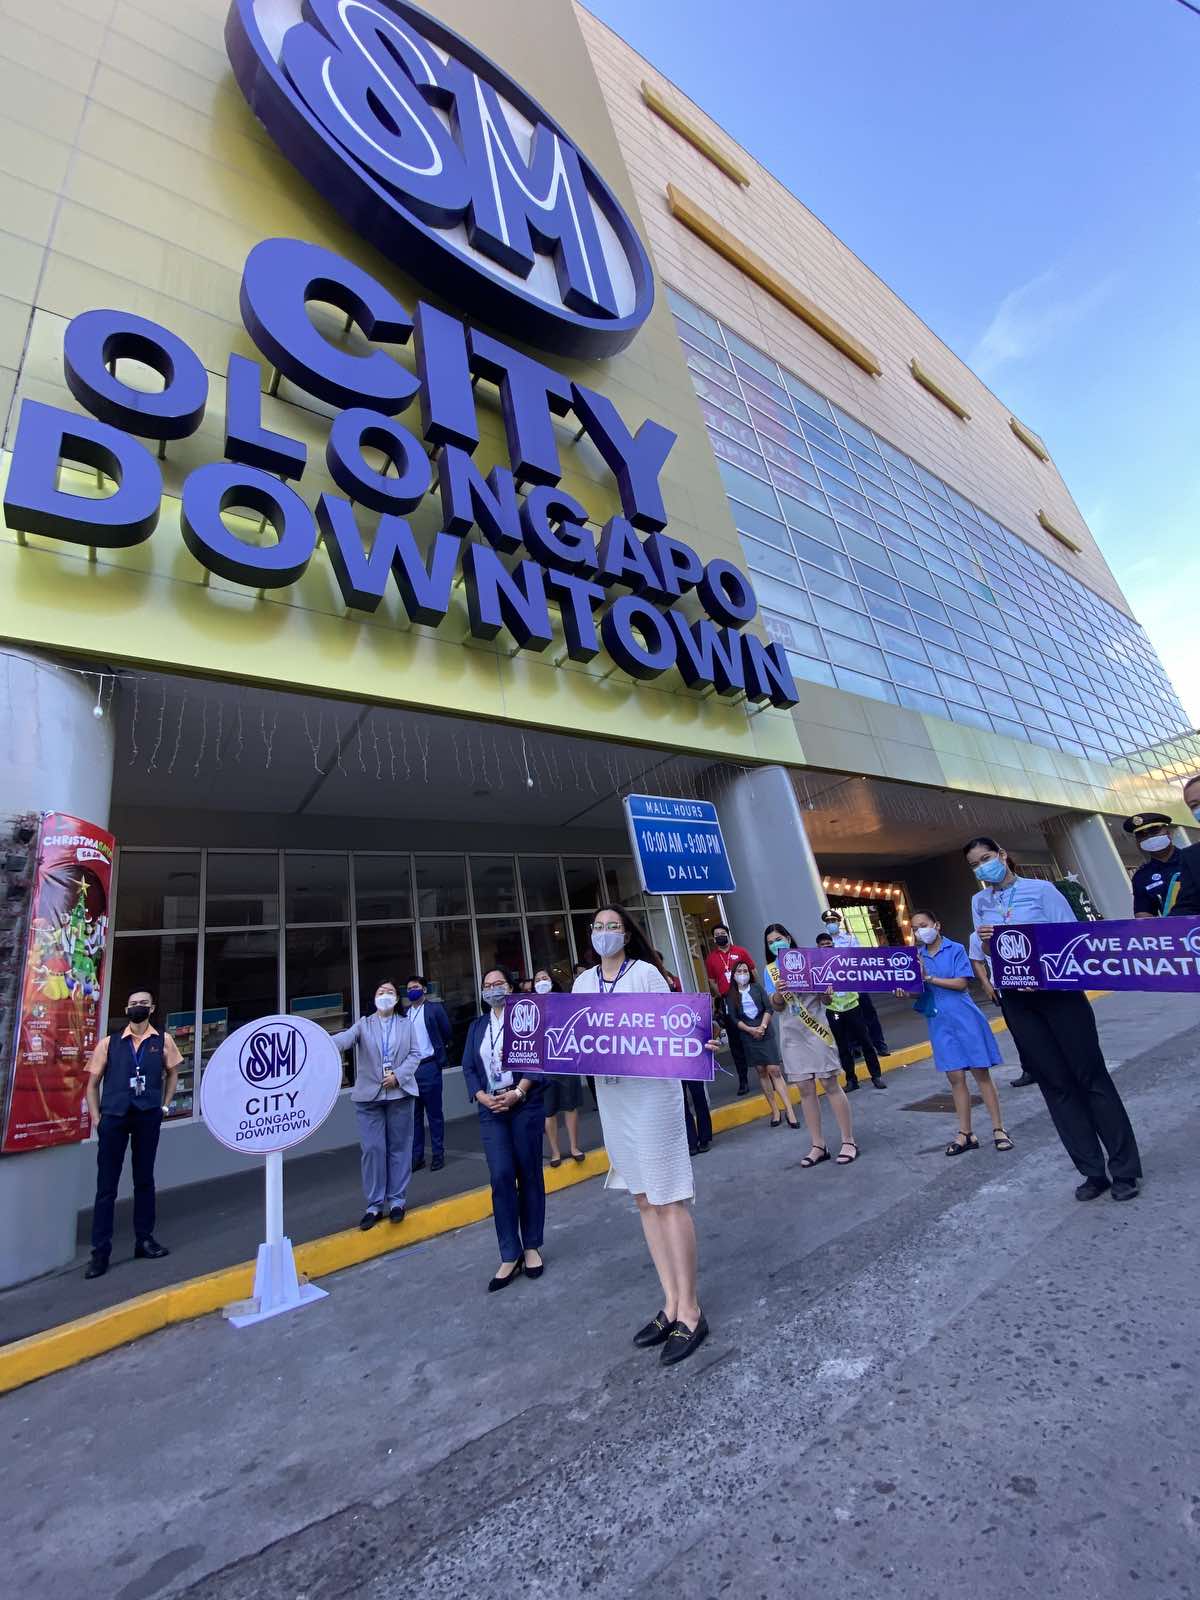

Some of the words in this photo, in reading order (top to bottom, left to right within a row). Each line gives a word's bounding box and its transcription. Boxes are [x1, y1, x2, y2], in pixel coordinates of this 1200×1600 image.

[280, 0, 621, 320] SM
[240, 237, 677, 530] CITY
[63, 309, 757, 629] OLONGAPO
[4, 399, 799, 709] DOWNTOWN
[645, 801, 671, 815] MALL
[673, 803, 703, 818] HOURS
[642, 830, 668, 853] 10:00
[668, 831, 684, 853] AM
[687, 832, 707, 854] 9:00
[706, 833, 721, 854] PM
[667, 865, 709, 880] DAILY
[999, 934, 1027, 960] SM
[1085, 937, 1123, 952] WE
[1127, 936, 1175, 952] ARE
[837, 957, 858, 967] WE
[860, 957, 886, 967] ARE
[1003, 965, 1031, 975] CITY
[787, 973, 805, 981] CITY
[512, 1003, 536, 1033] SM
[586, 1012, 614, 1028] WE
[618, 1012, 656, 1029] ARE
[660, 1011, 702, 1031] 100%
[798, 1007, 830, 1039] SISTANT
[245, 1030, 297, 1082] SM
[509, 1051, 538, 1059] OLONGAPO
[511, 1040, 536, 1051] CITY
[507, 1057, 540, 1065] DOWNTOWN
[245, 1090, 299, 1116] CITY
[235, 1118, 311, 1141] DOWNTOWN
[239, 1109, 306, 1131] OLONGAPO
